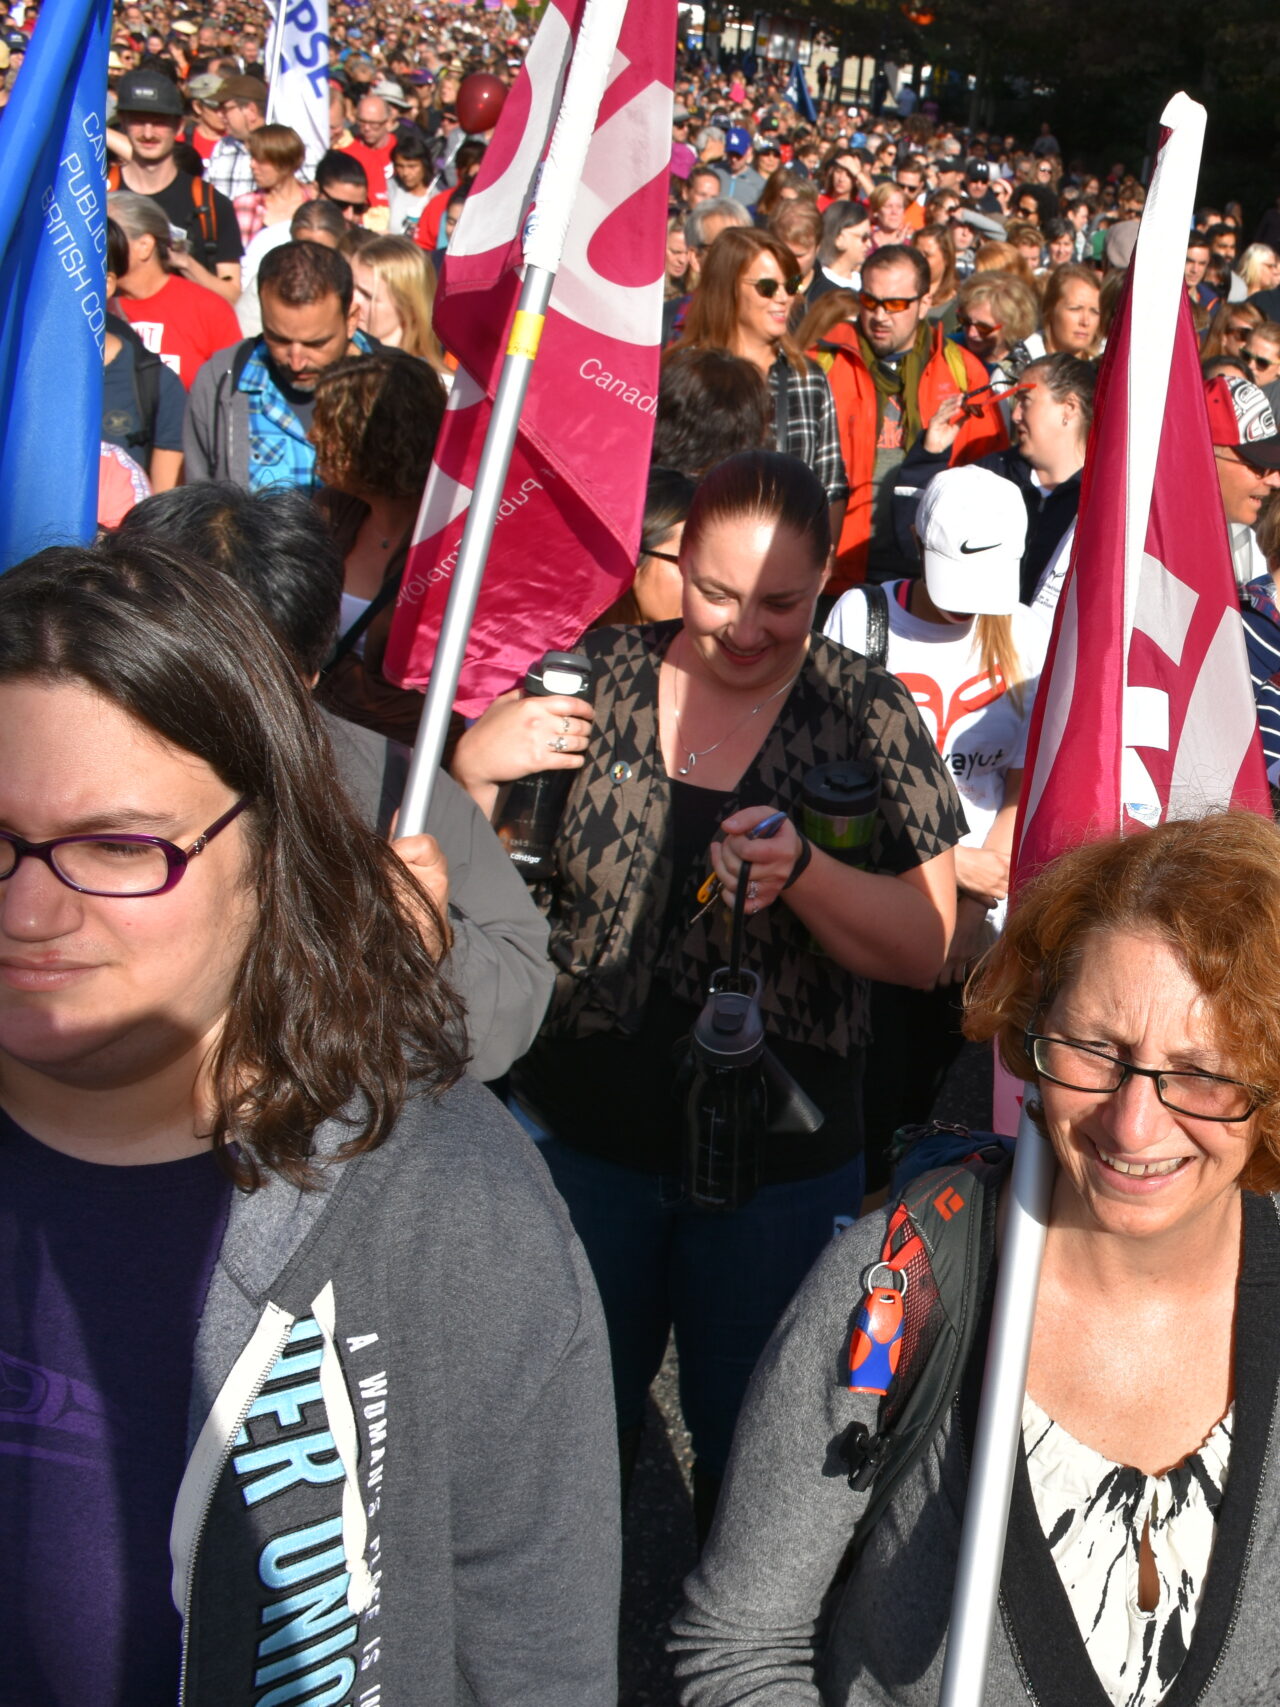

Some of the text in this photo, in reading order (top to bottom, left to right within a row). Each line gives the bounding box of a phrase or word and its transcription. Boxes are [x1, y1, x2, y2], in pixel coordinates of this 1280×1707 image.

[82, 112, 107, 180] CAN
[42, 185, 106, 360] BRITISH COL
[510, 852, 541, 864] contigo
[346, 1332, 379, 1353] A
[359, 1371, 388, 1517] WOMAN'S
[361, 1636, 381, 1671] IS
